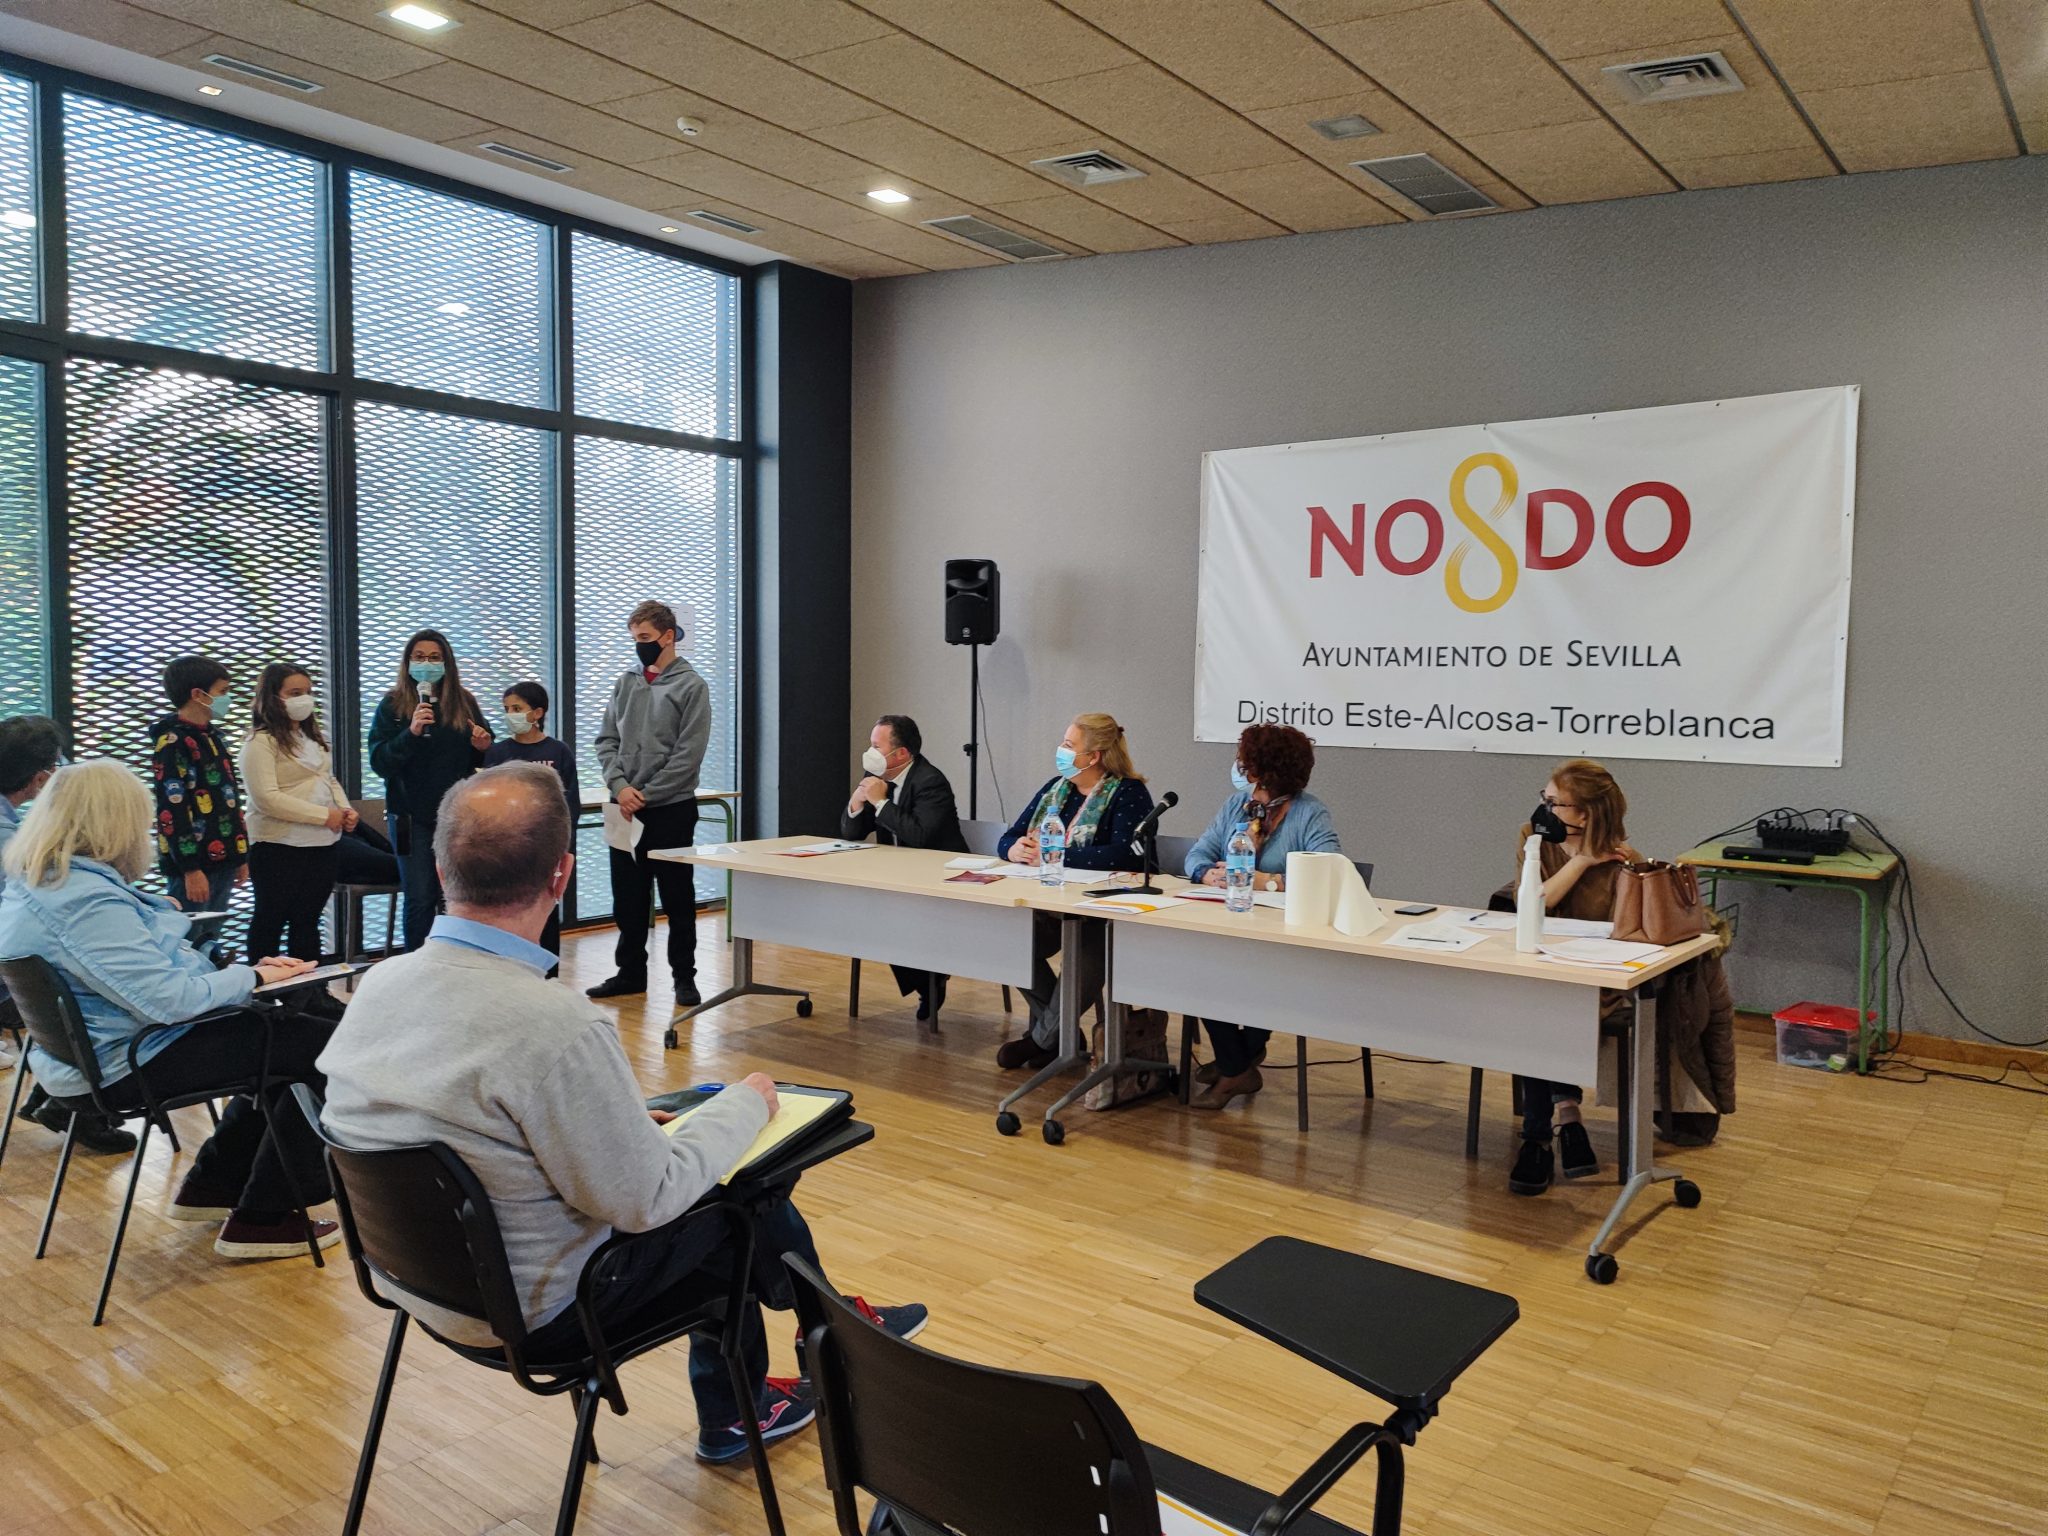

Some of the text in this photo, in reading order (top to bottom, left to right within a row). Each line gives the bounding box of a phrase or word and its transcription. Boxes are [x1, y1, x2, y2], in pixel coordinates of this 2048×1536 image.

[1302, 639, 1682, 668] AYUNTAMIENTO DE SEVILLA
[1237, 700, 1775, 740] Distrito Este-Alcosa-Torreblanca
